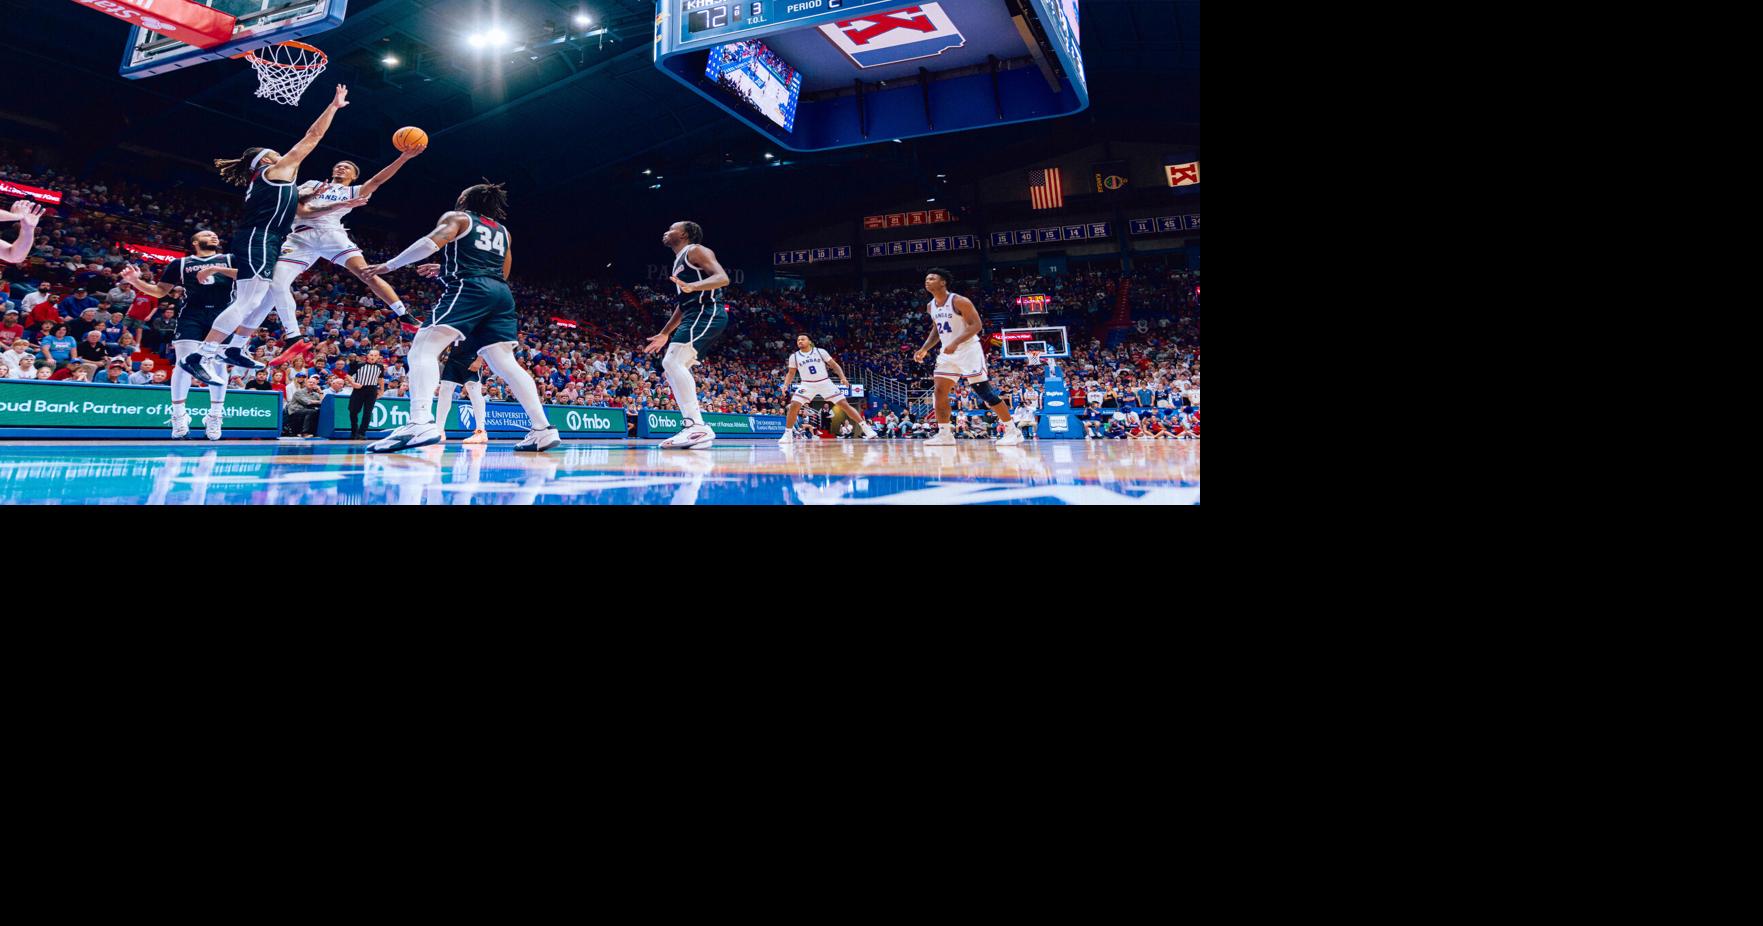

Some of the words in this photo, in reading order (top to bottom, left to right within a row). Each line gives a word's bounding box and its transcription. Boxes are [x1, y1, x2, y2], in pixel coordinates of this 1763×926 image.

[753, 2, 762, 15] 3
[787, 0, 822, 14] PERIOD
[697, 6, 727, 28] 72
[474, 224, 505, 257] 34
[937, 321, 953, 334] 24
[808, 365, 817, 375] 8
[34, 399, 79, 413] Bank
[82, 401, 144, 415] Partner
[146, 404, 163, 415] of
[164, 406, 212, 417] Knsas
[484, 419, 503, 427] ANSAS
[582, 413, 611, 430] fnbo
[658, 416, 677, 428] fnbo
